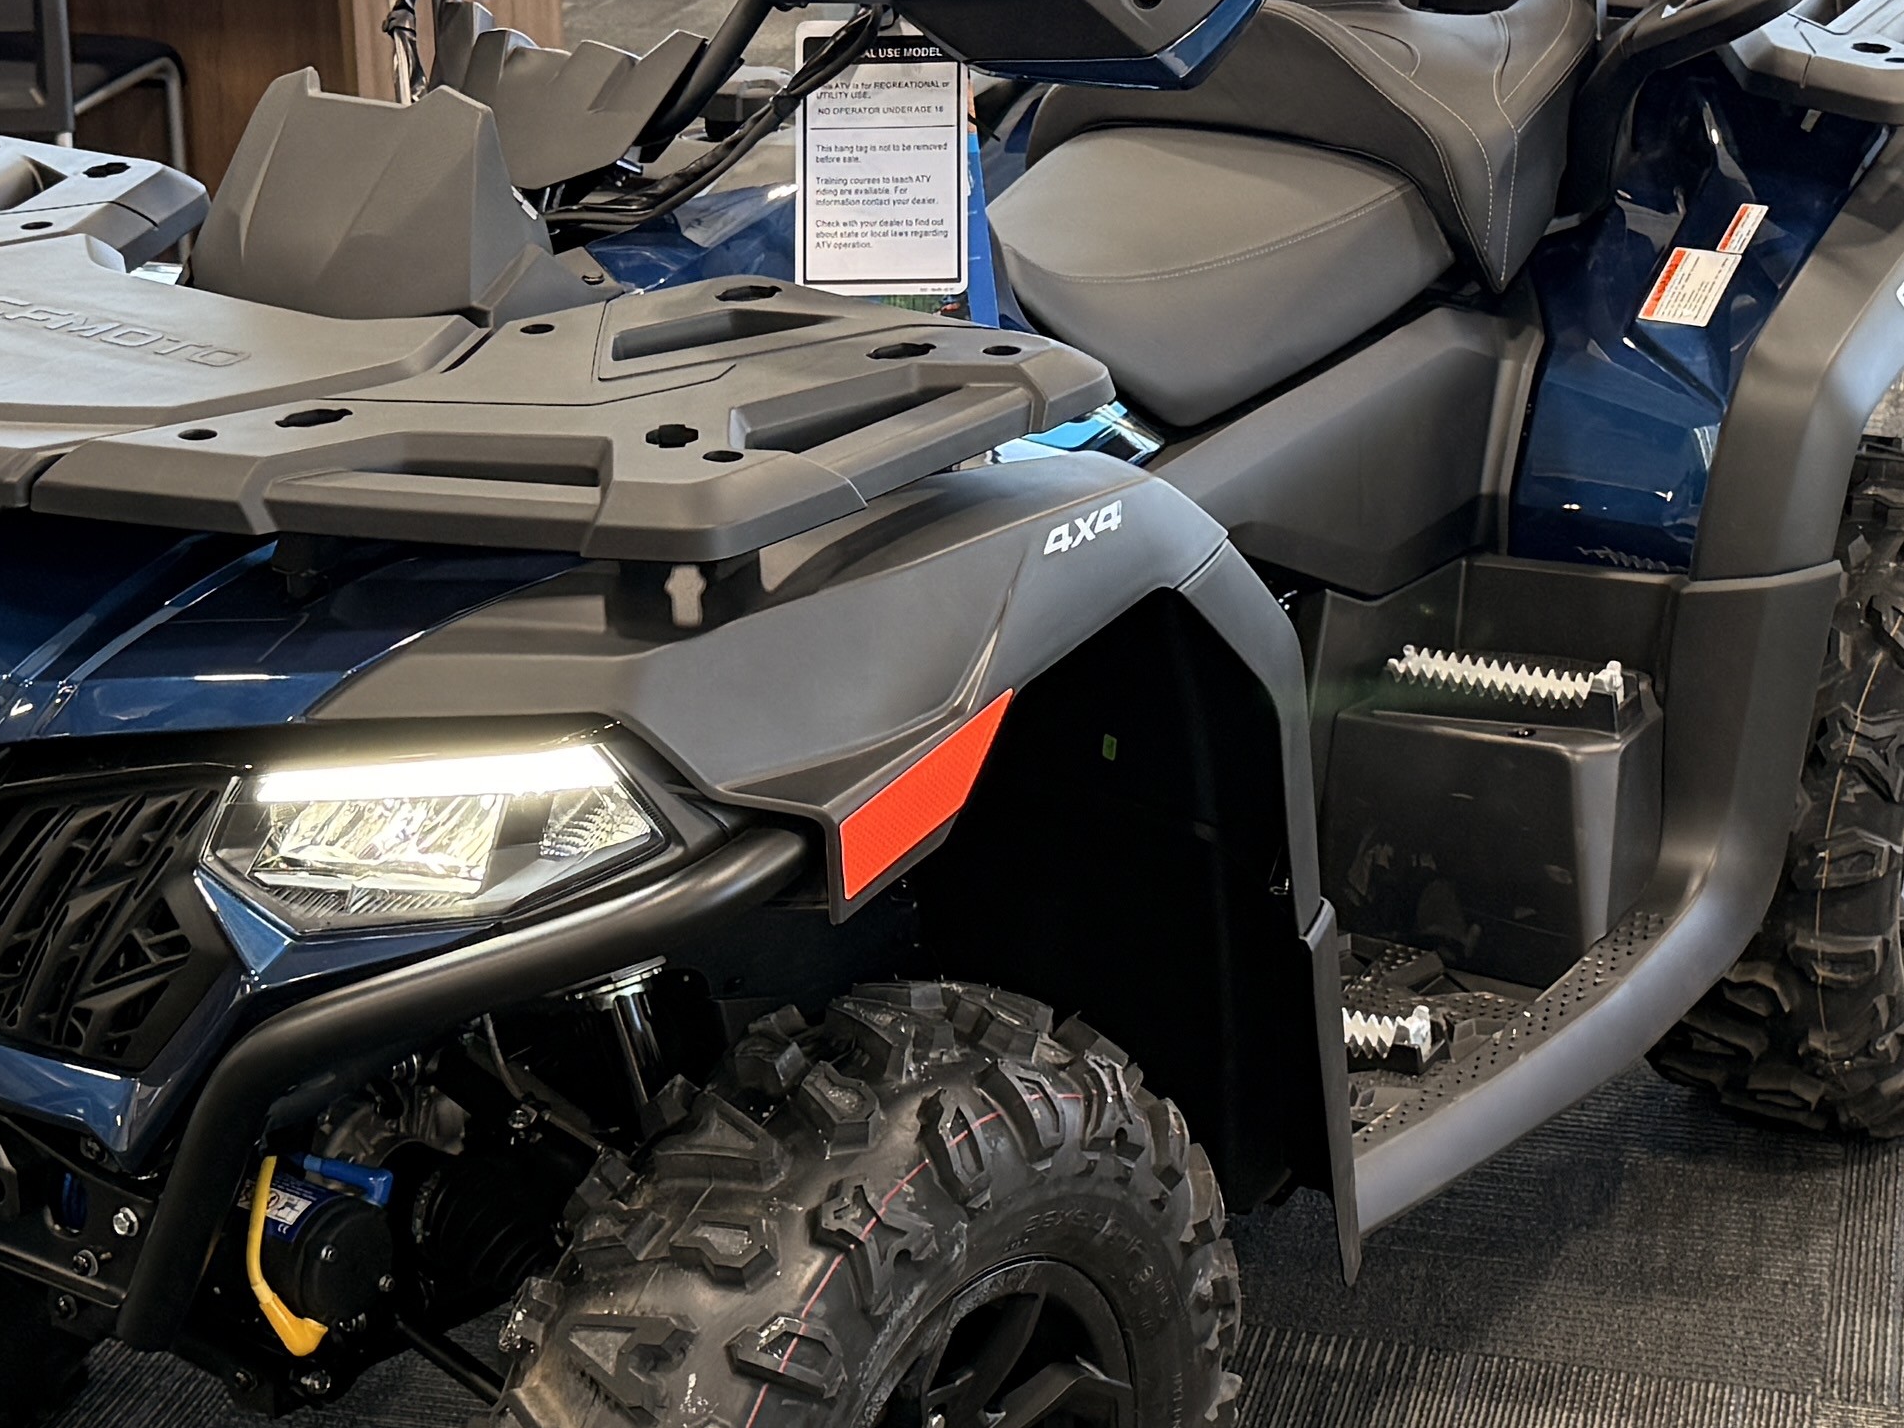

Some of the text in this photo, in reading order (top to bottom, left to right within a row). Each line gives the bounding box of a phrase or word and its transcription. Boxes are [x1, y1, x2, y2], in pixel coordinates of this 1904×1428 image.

[879, 48, 900, 58] USE
[904, 48, 942, 57] MODEL
[874, 81, 939, 89] RECREATIONAL
[834, 144, 853, 153] hang
[856, 144, 868, 153] tag
[902, 143, 911, 151] be
[913, 142, 947, 151] removed
[816, 176, 848, 186] Training
[882, 176, 890, 184] to
[816, 188, 837, 196] riding
[894, 186, 907, 194] For
[816, 198, 860, 206] information
[892, 199, 909, 207] your
[816, 220, 840, 228] Check
[860, 220, 877, 228] your
[879, 219, 903, 227] dealer
[915, 218, 929, 226] find
[816, 231, 838, 239] about
[910, 230, 948, 239] regarding
[833, 242, 872, 250] operation.
